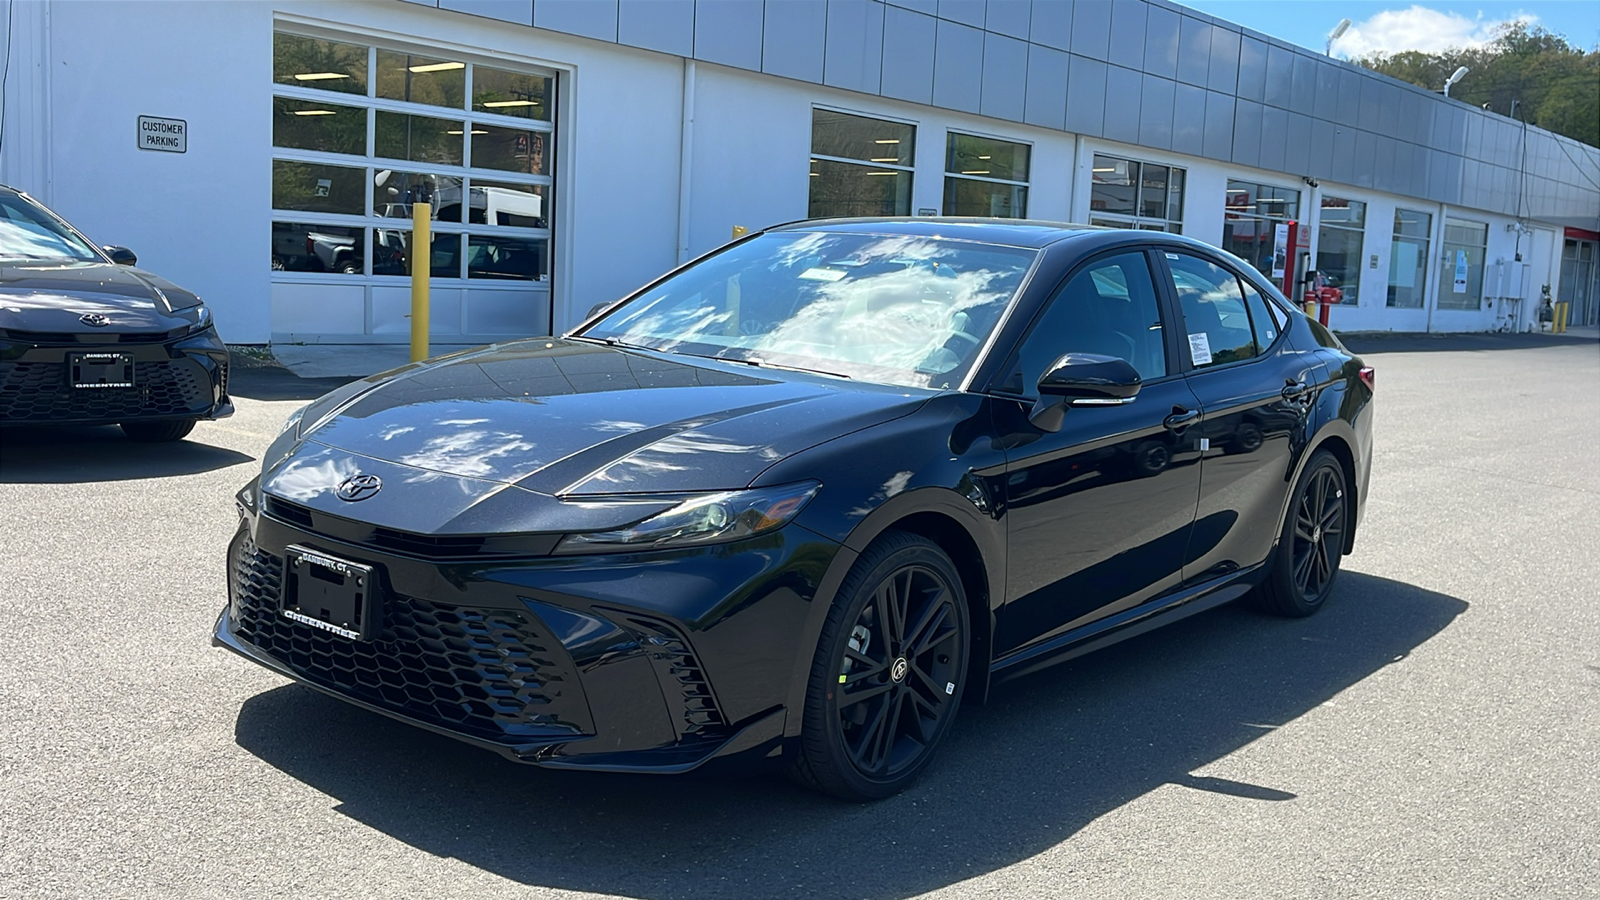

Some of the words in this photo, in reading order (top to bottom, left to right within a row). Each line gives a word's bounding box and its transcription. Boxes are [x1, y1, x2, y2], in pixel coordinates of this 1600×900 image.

[142, 121, 183, 135] CUSTOMER
[146, 135, 179, 148] PARKING
[336, 562, 348, 573] CT
[283, 610, 361, 641] GREENTREE
